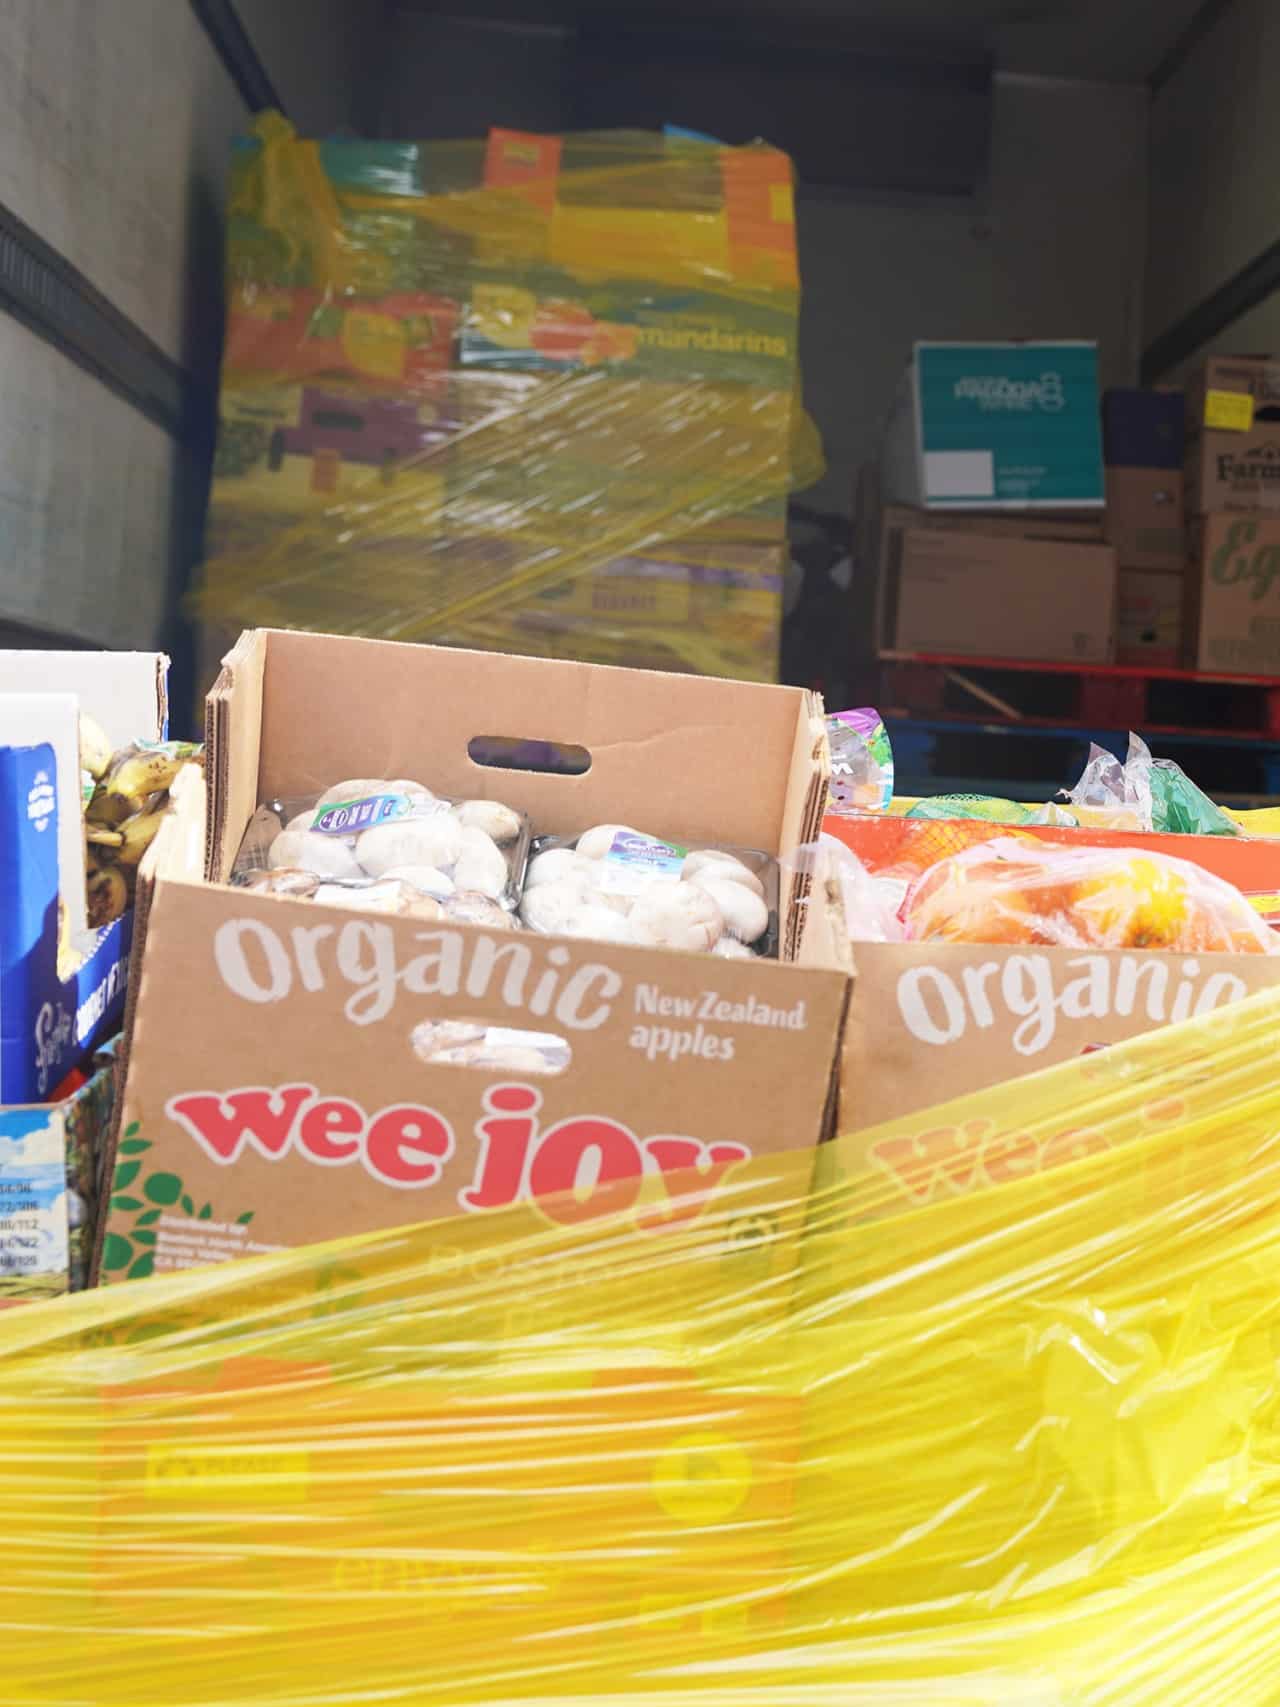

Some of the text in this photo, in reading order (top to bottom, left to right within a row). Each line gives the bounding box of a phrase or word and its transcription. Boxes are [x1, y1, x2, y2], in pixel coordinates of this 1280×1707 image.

[638, 326, 788, 358] mandarins
[213, 916, 623, 1031] Organic
[634, 983, 808, 1031] New Zealand
[628, 1023, 736, 1062] apples
[165, 1084, 752, 1234] wee joy
